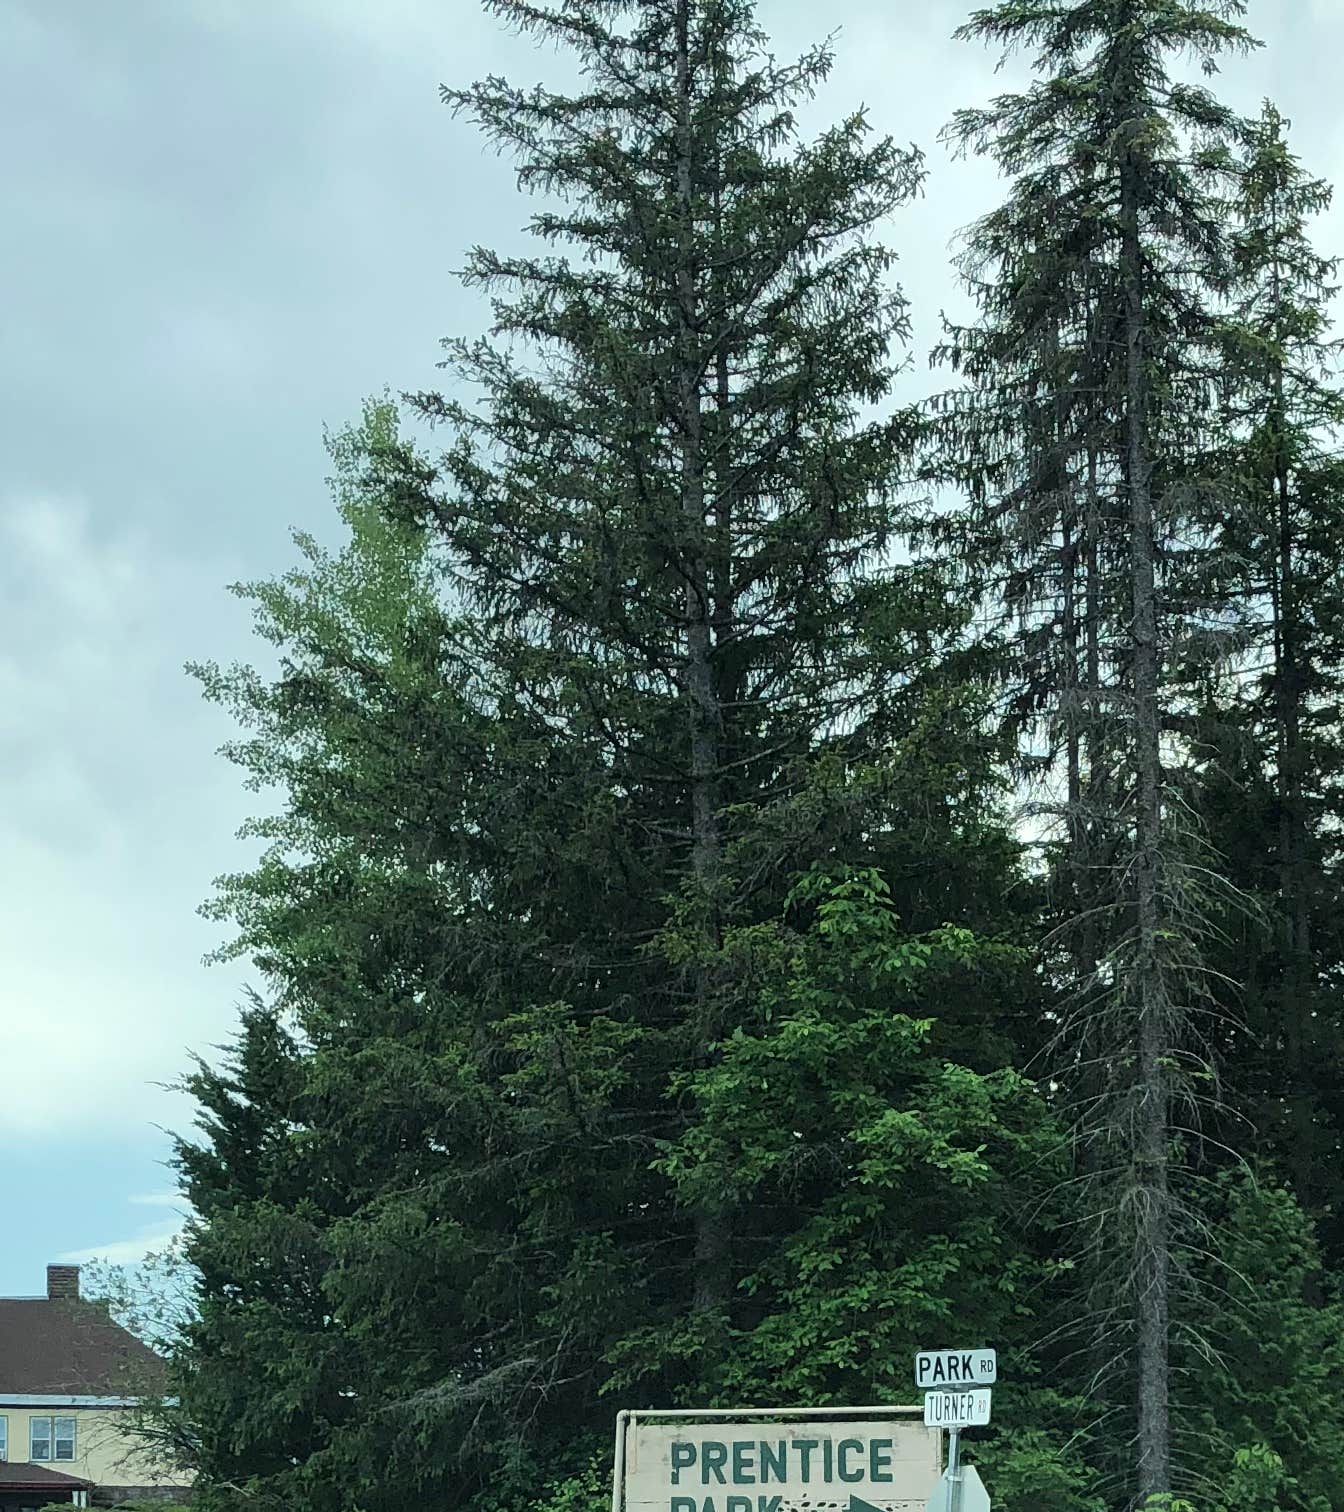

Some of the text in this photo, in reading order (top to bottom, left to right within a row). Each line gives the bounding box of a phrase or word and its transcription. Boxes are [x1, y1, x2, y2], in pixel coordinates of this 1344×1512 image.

[919, 1354, 994, 1382] PARK RD
[929, 1394, 987, 1421] TURNER RD
[671, 1438, 893, 1485] PRENTICE
